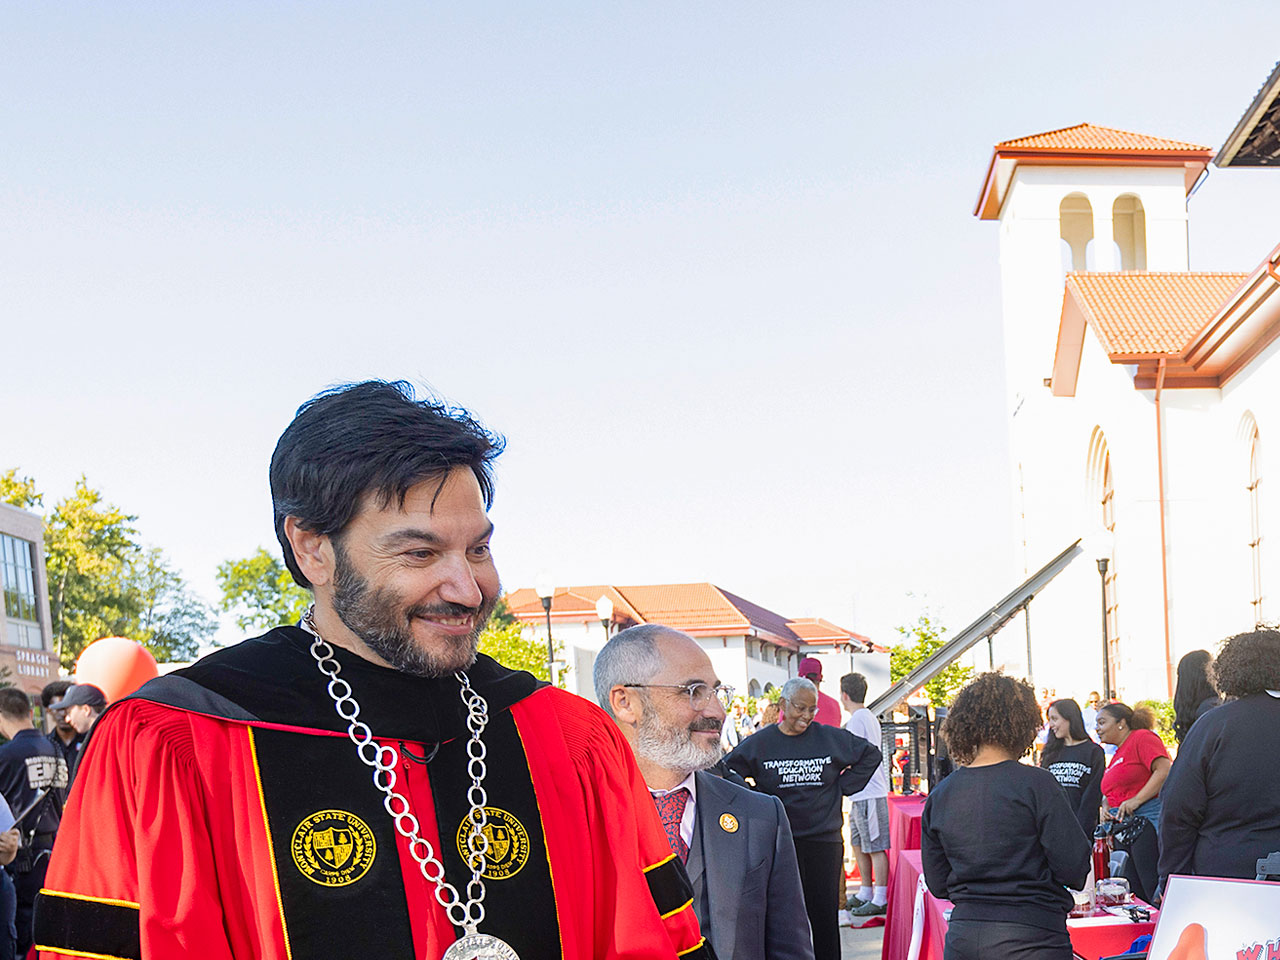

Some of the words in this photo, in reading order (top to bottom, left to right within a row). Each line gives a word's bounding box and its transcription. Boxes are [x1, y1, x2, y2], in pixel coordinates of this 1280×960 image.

[17, 663, 49, 678] LIBRARY
[763, 756, 832, 770] TRANSFORMATIVE
[778, 765, 823, 775] EDUCATION
[782, 773, 822, 783] NETWORK
[293, 820, 315, 876] MONTCLAIR
[313, 812, 346, 824] STATE
[346, 815, 373, 870] UNIVERSITY
[503, 813, 527, 865] UNIVERSITY
[325, 874, 352, 884] 1908
